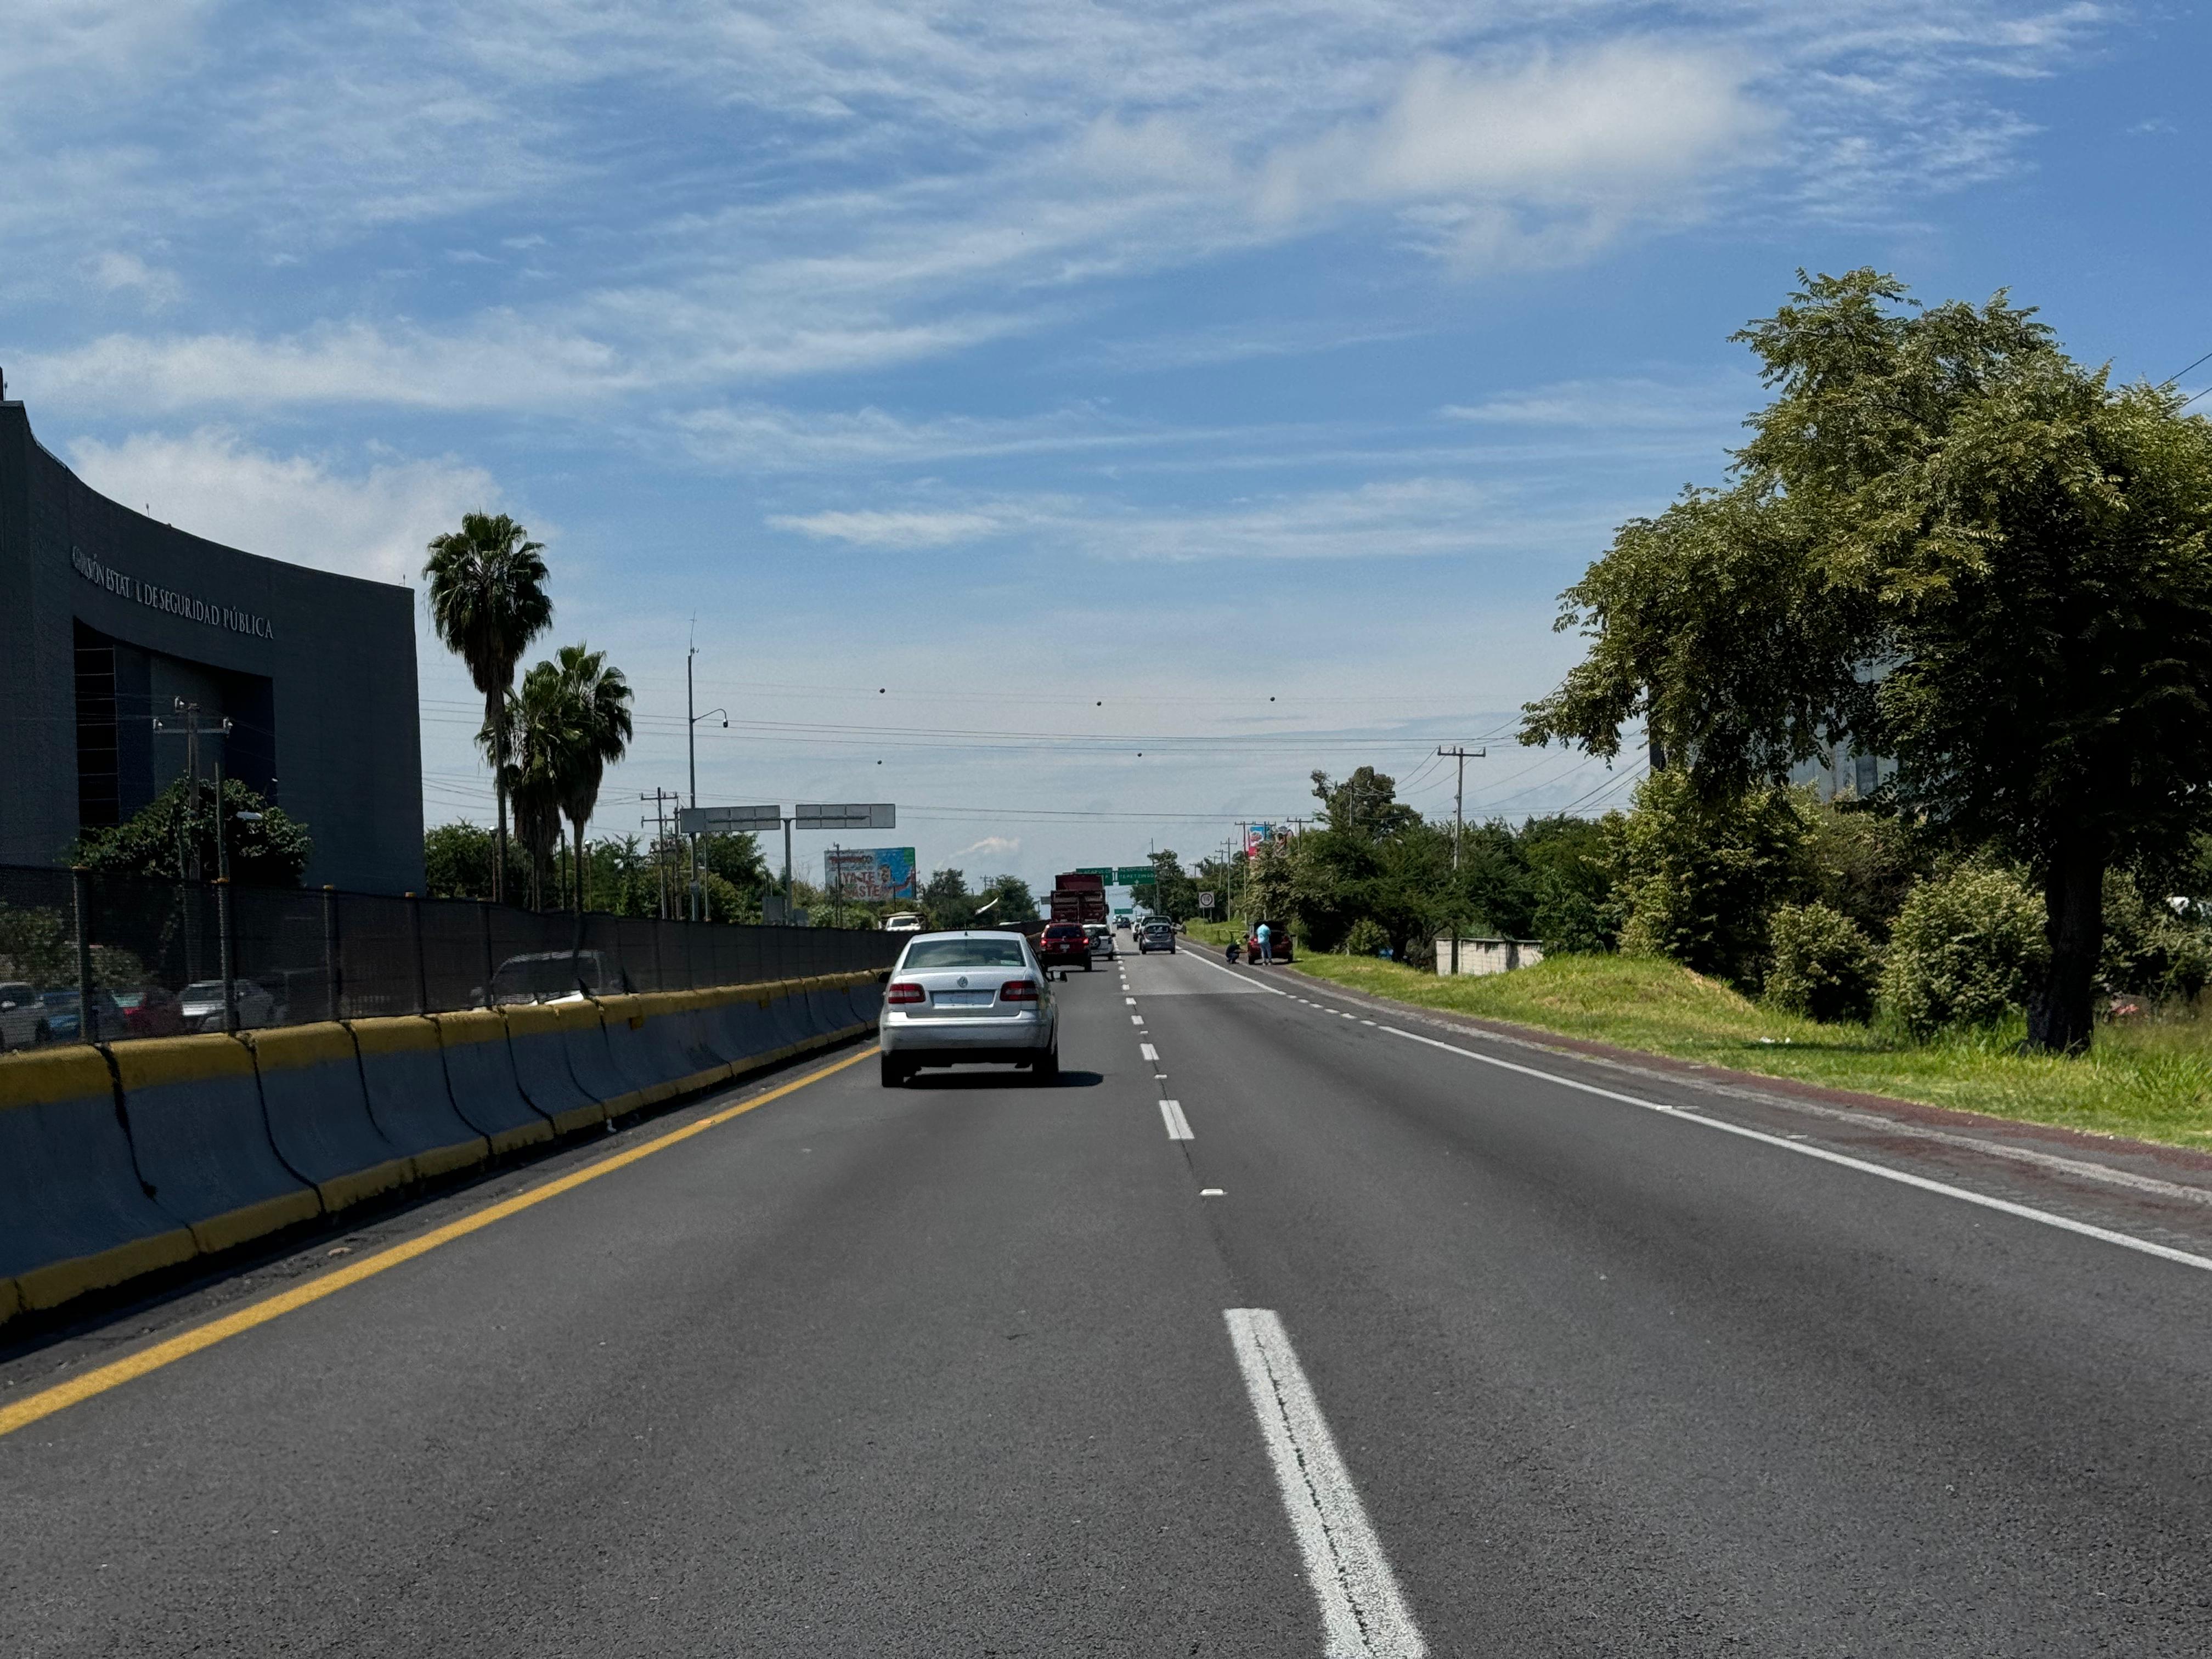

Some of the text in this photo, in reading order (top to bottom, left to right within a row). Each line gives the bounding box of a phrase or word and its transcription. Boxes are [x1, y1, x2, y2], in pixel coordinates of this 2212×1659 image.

[105, 567, 143, 602] ESTATL
[144, 584, 158, 608] DE
[159, 589, 219, 625] SEGURIDAD
[223, 605, 274, 640] PÚBLICA
